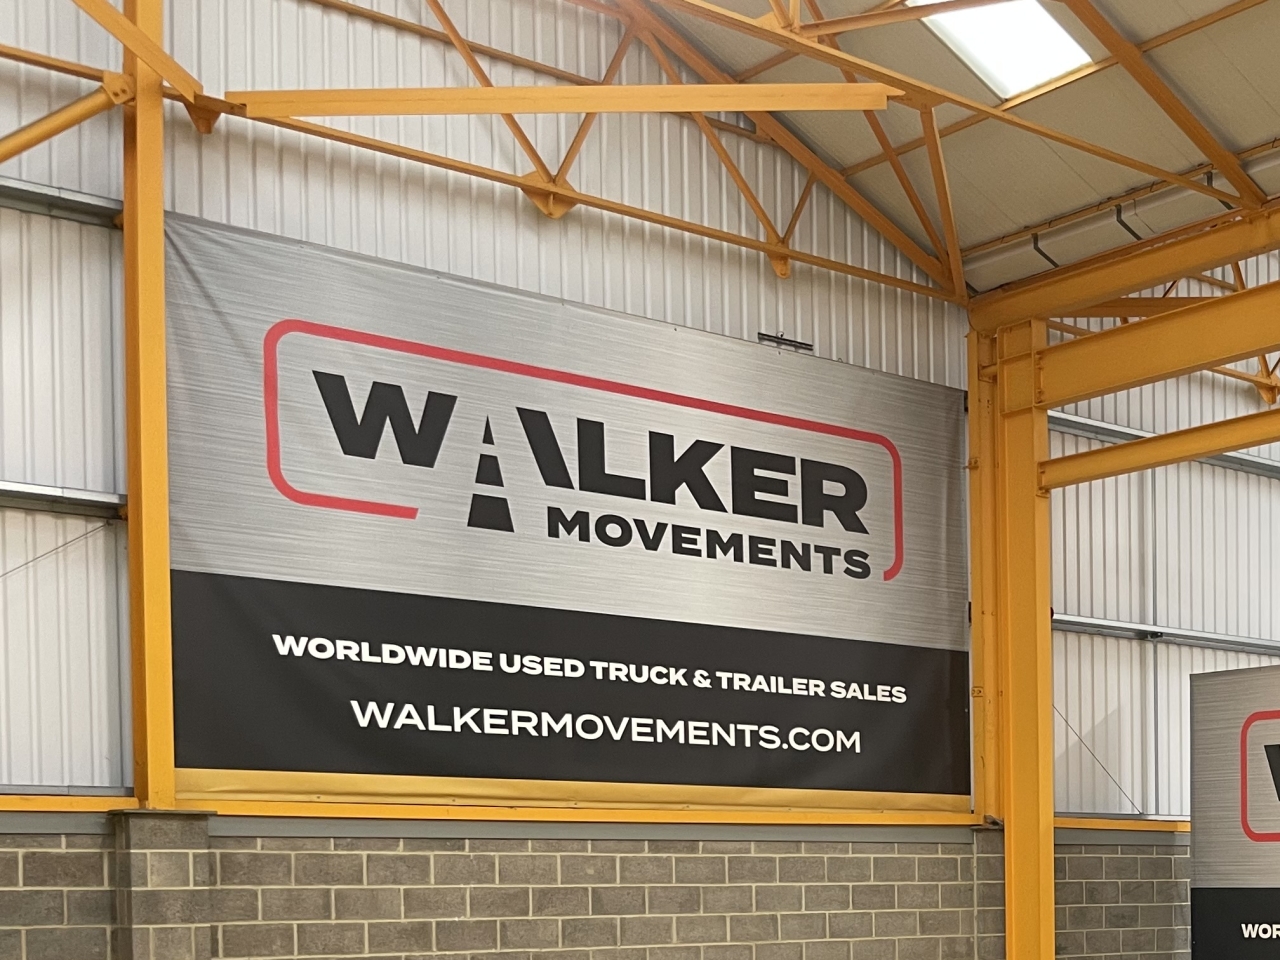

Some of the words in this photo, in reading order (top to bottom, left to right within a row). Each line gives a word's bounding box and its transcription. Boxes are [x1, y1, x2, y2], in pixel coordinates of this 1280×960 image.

[312, 369, 871, 533] WALKER
[547, 506, 871, 581] MOVEMENTS
[272, 633, 493, 672] WORLDWIDE
[499, 652, 585, 678] USED
[589, 660, 688, 686] TRUCK
[692, 669, 713, 689] &
[715, 671, 826, 698] TRAILER
[830, 681, 907, 703] SALES
[350, 700, 861, 753] WALKERMOVEMENTS.COM
